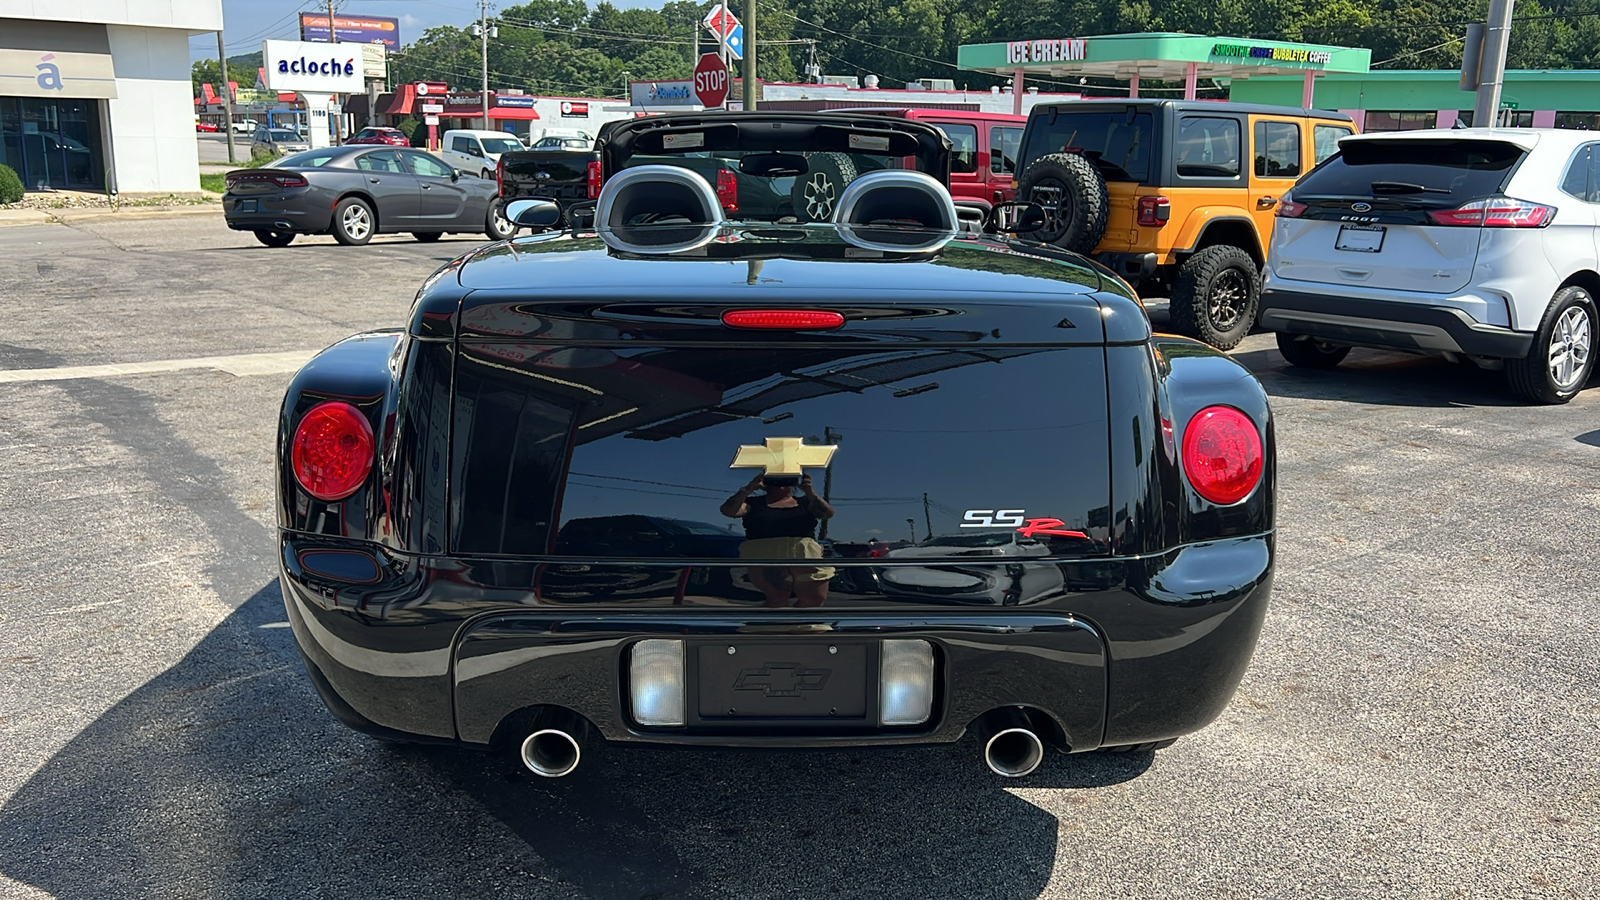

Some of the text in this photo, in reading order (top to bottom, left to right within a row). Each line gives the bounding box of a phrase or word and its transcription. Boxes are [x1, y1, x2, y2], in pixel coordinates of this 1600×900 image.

[1006, 39, 1086, 64] ICE CREAM
[1309, 50, 1332, 64] COFFEE
[278, 56, 354, 76] acloché
[696, 69, 726, 93] STOP
[656, 86, 690, 99] Domino's
[959, 509, 1088, 538] SSR
